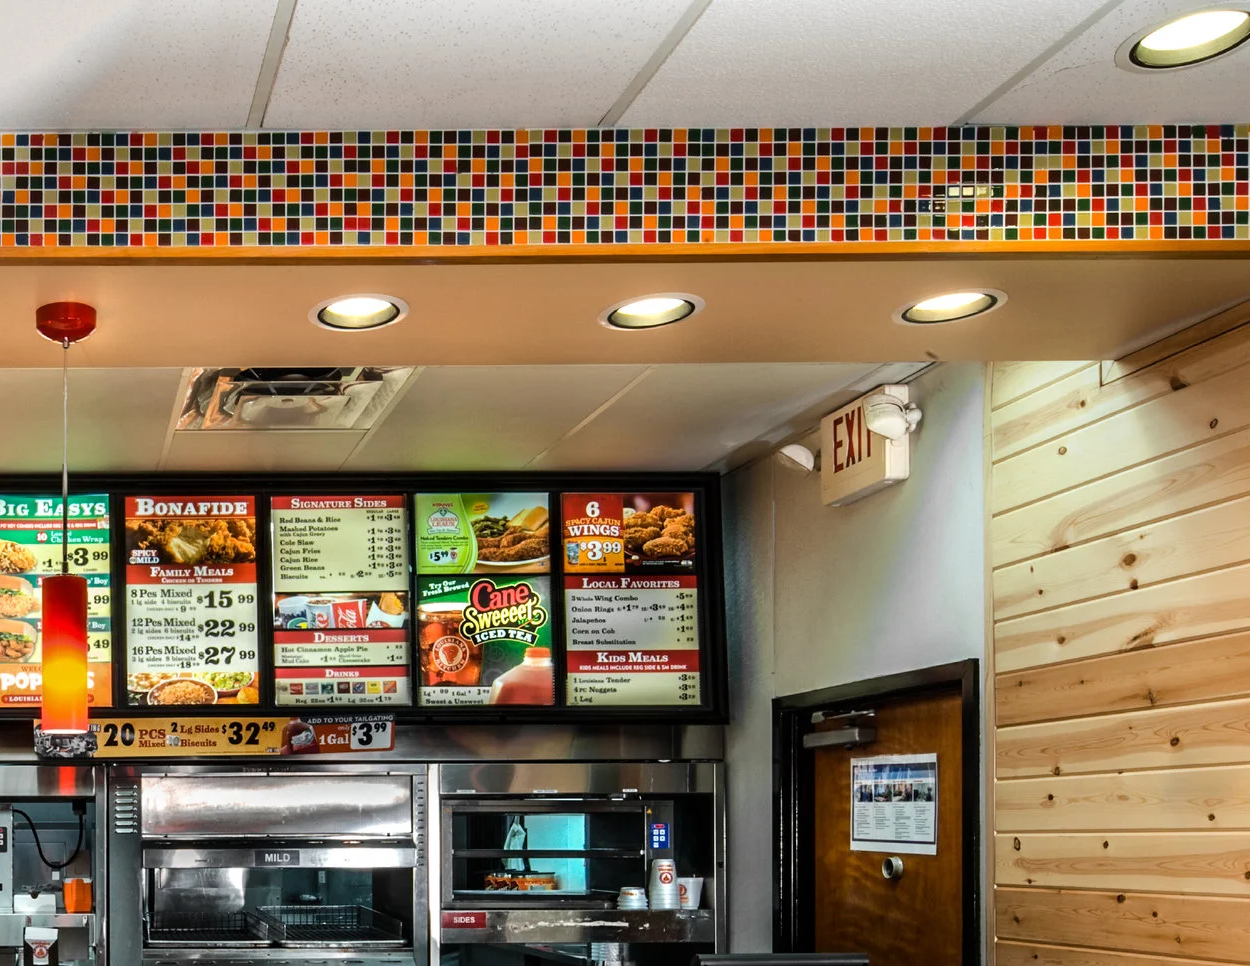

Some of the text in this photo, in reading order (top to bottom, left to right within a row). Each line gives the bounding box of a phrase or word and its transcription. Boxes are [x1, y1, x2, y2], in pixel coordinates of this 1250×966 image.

[135, 498, 248, 515] BONAFIDE
[291, 498, 387, 508] SIGNATURE SIDES
[586, 501, 600, 517] 6
[568, 525, 620, 537] WINGS
[150, 566, 234, 577] FAMILY MEALS
[582, 578, 680, 588] LOCAL FAVORITES
[131, 589, 137, 597] 8
[160, 589, 192, 597] Mixed
[472, 583, 530, 612] Cane
[132, 618, 145, 626] 12
[164, 618, 196, 626] Mixed
[313, 632, 369, 642] DESSERTS
[474, 629, 533, 643] ICED TEA
[132, 647, 144, 655] 16
[164, 646, 196, 654] Mixed
[597, 652, 668, 663] KIDS MEALS
[325, 669, 359, 677] DRINKS
[171, 722, 178, 733] 2
[103, 723, 166, 747] 20 PCS
[139, 740, 166, 748] Mixed
[180, 739, 217, 747] Biscuits
[264, 853, 290, 862] MILD
